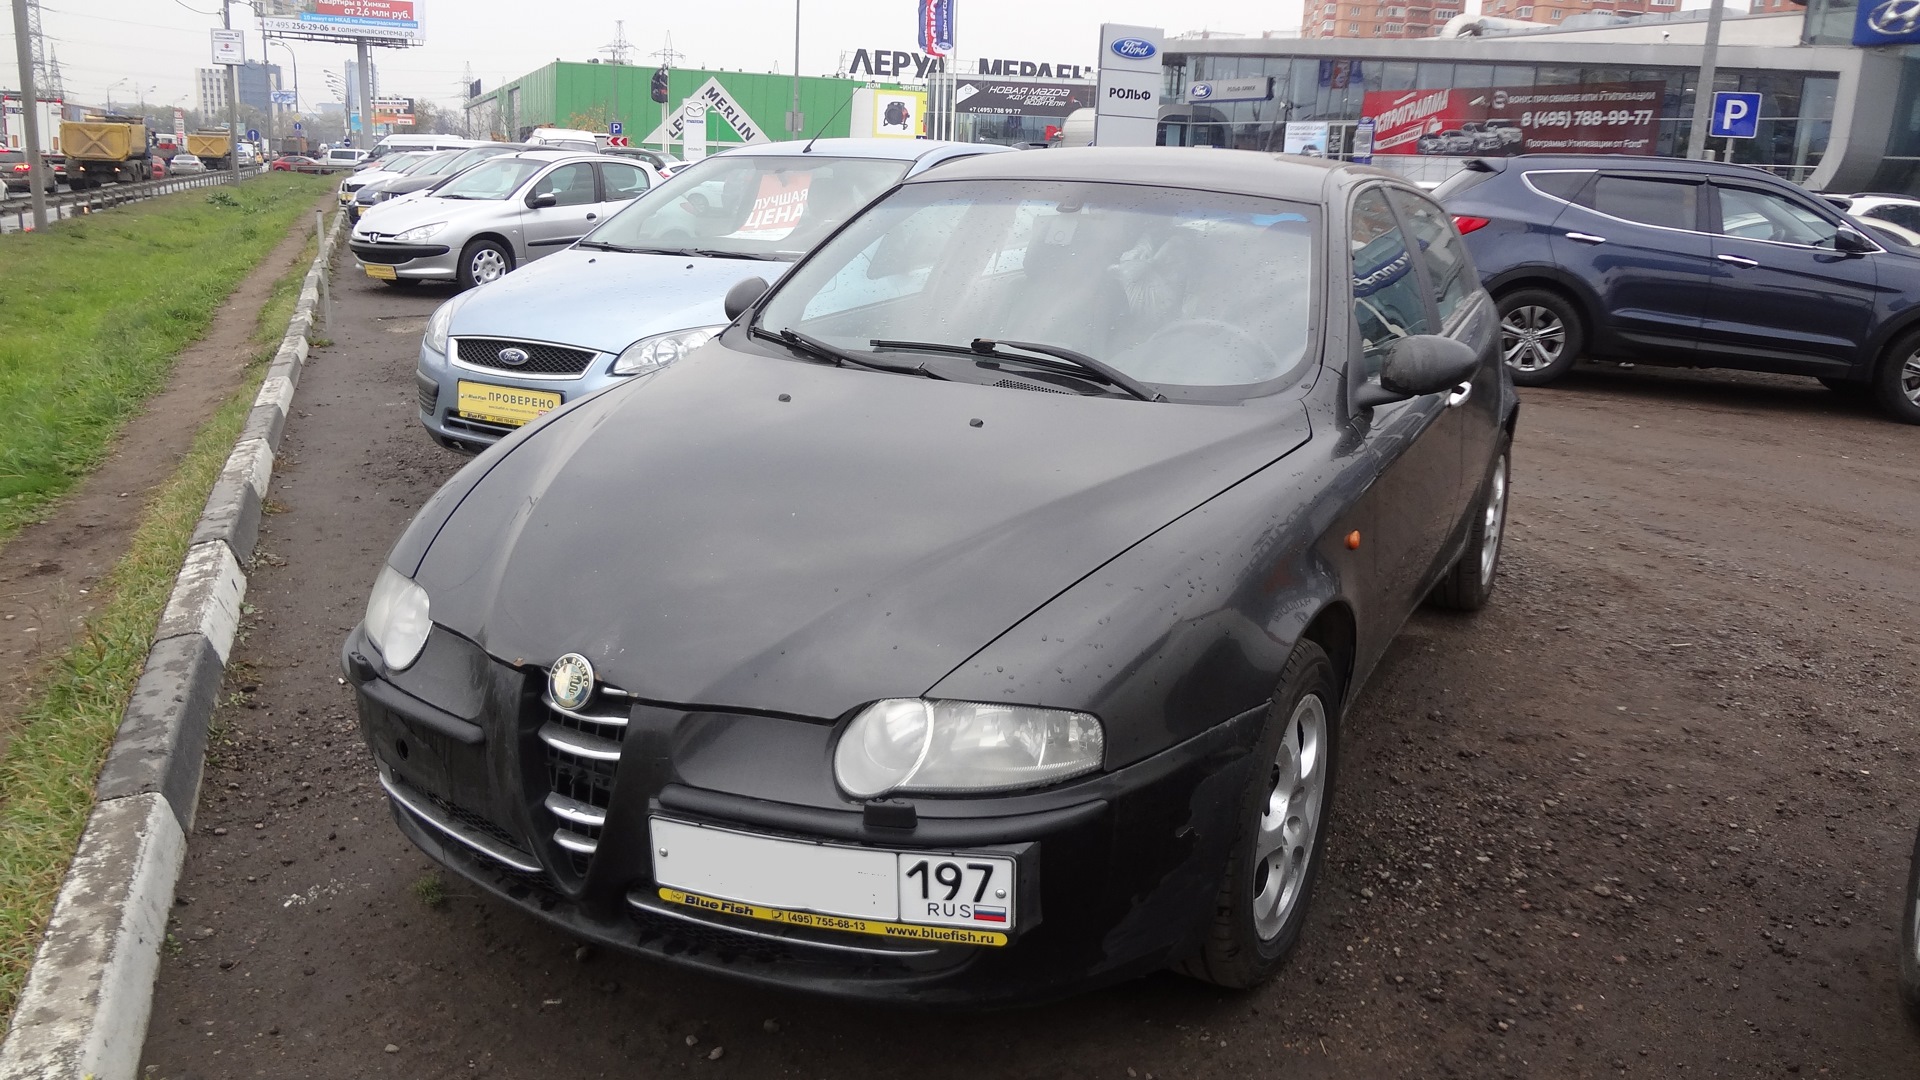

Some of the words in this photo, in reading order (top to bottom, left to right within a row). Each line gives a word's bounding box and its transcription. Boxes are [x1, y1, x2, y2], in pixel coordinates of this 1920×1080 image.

[356, 8, 370, 17] 2,6
[392, 10, 411, 19] руб.
[292, 22, 329, 31] 256-29-06
[337, 27, 415, 38] солнечнаясистема.рф
[1120, 39, 1149, 56] Ford
[988, 85, 1029, 95] НОВАЯ
[1109, 87, 1151, 101] РОЛЬФ
[705, 86, 756, 141] MERLIN
[977, 106, 992, 114] (495)
[1374, 89, 1451, 134] ОСПРОГРАММА
[1520, 111, 1532, 127] 8
[1532, 110, 1572, 129] (495)
[1573, 109, 1654, 127] 788-99-77
[1722, 99, 1748, 130] P
[612, 123, 621, 134] P
[753, 188, 809, 211] ЛУЧШАЯ
[744, 203, 804, 229] ЦЕНА
[488, 391, 555, 409] ПРОВЕРЕНО
[551, 658, 568, 680] ALFA
[571, 657, 589, 688] ROMEO
[905, 859, 994, 903] 197
[684, 894, 719, 911] Blue
[720, 902, 754, 917] Fish
[787, 912, 813, 926] (495)
[815, 915, 866, 931] 755-68-13
[885, 925, 995, 945] www.bluefish.ru
[927, 902, 972, 919] RUS
